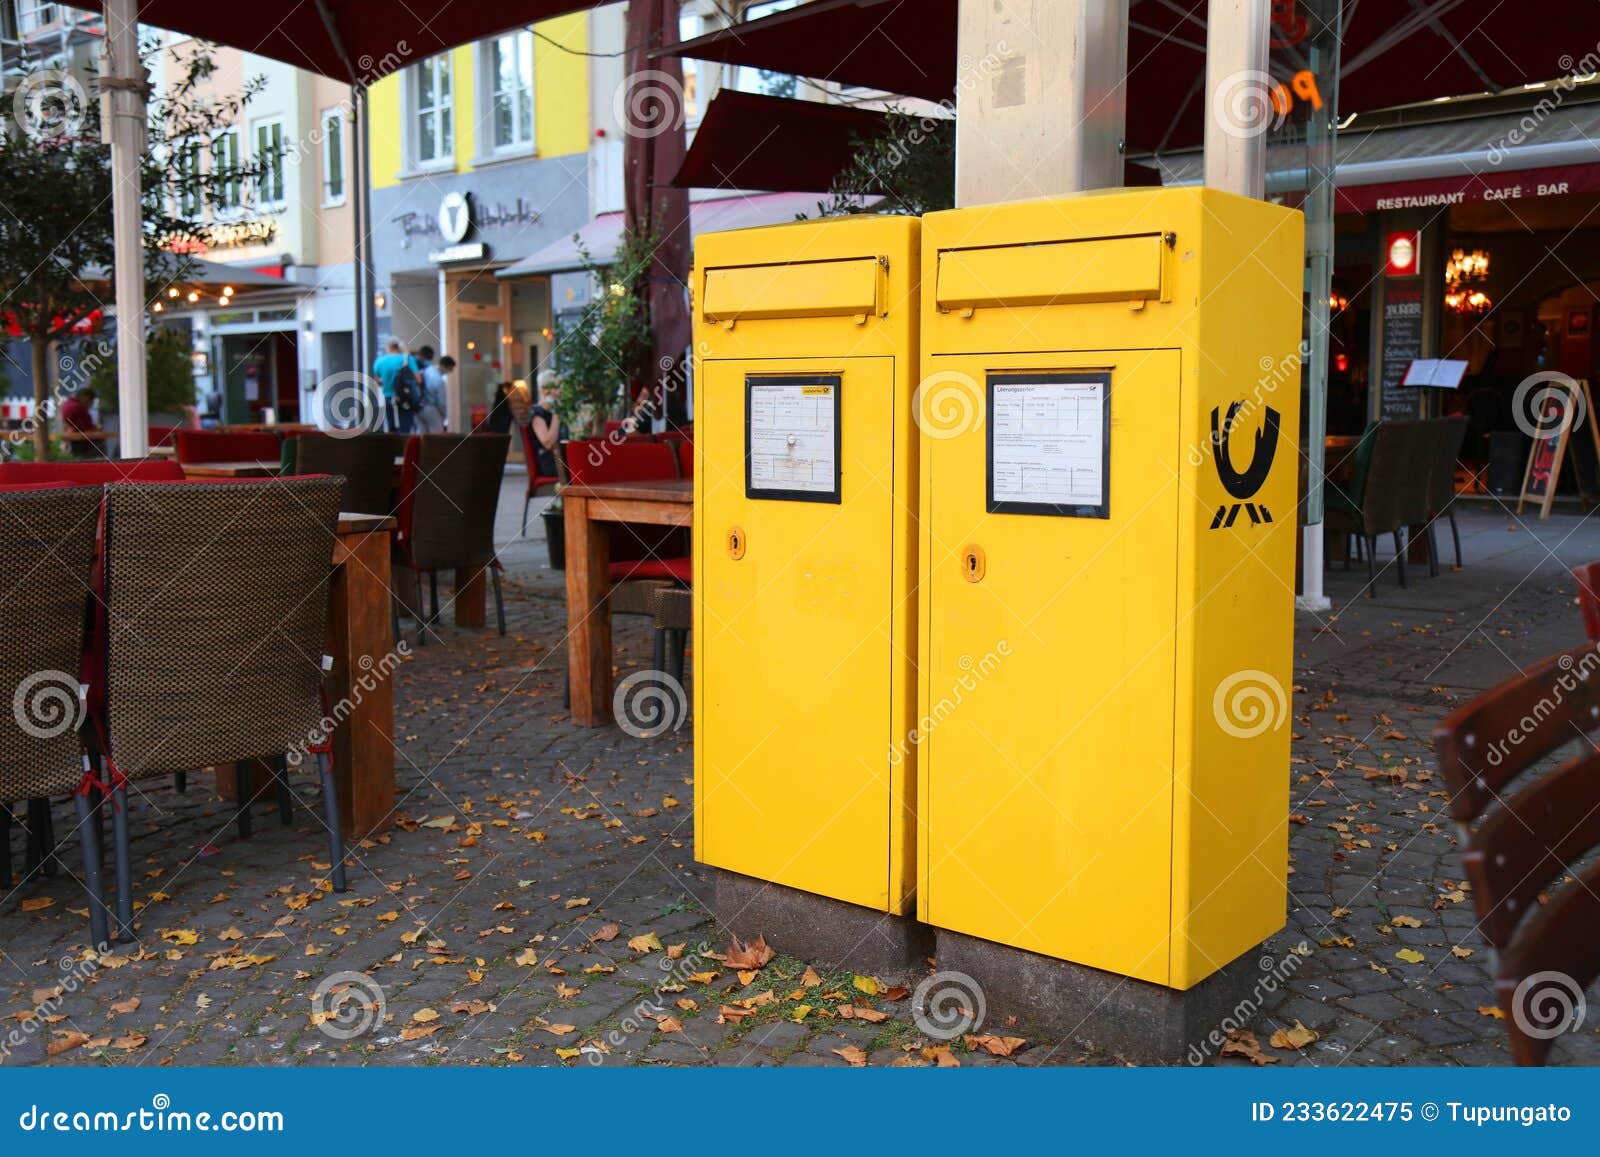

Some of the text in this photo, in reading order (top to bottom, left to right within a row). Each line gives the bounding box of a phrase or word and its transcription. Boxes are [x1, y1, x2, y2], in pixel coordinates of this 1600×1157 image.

[1376, 182, 1569, 210] RESTAURANT CAFÉ BAR
